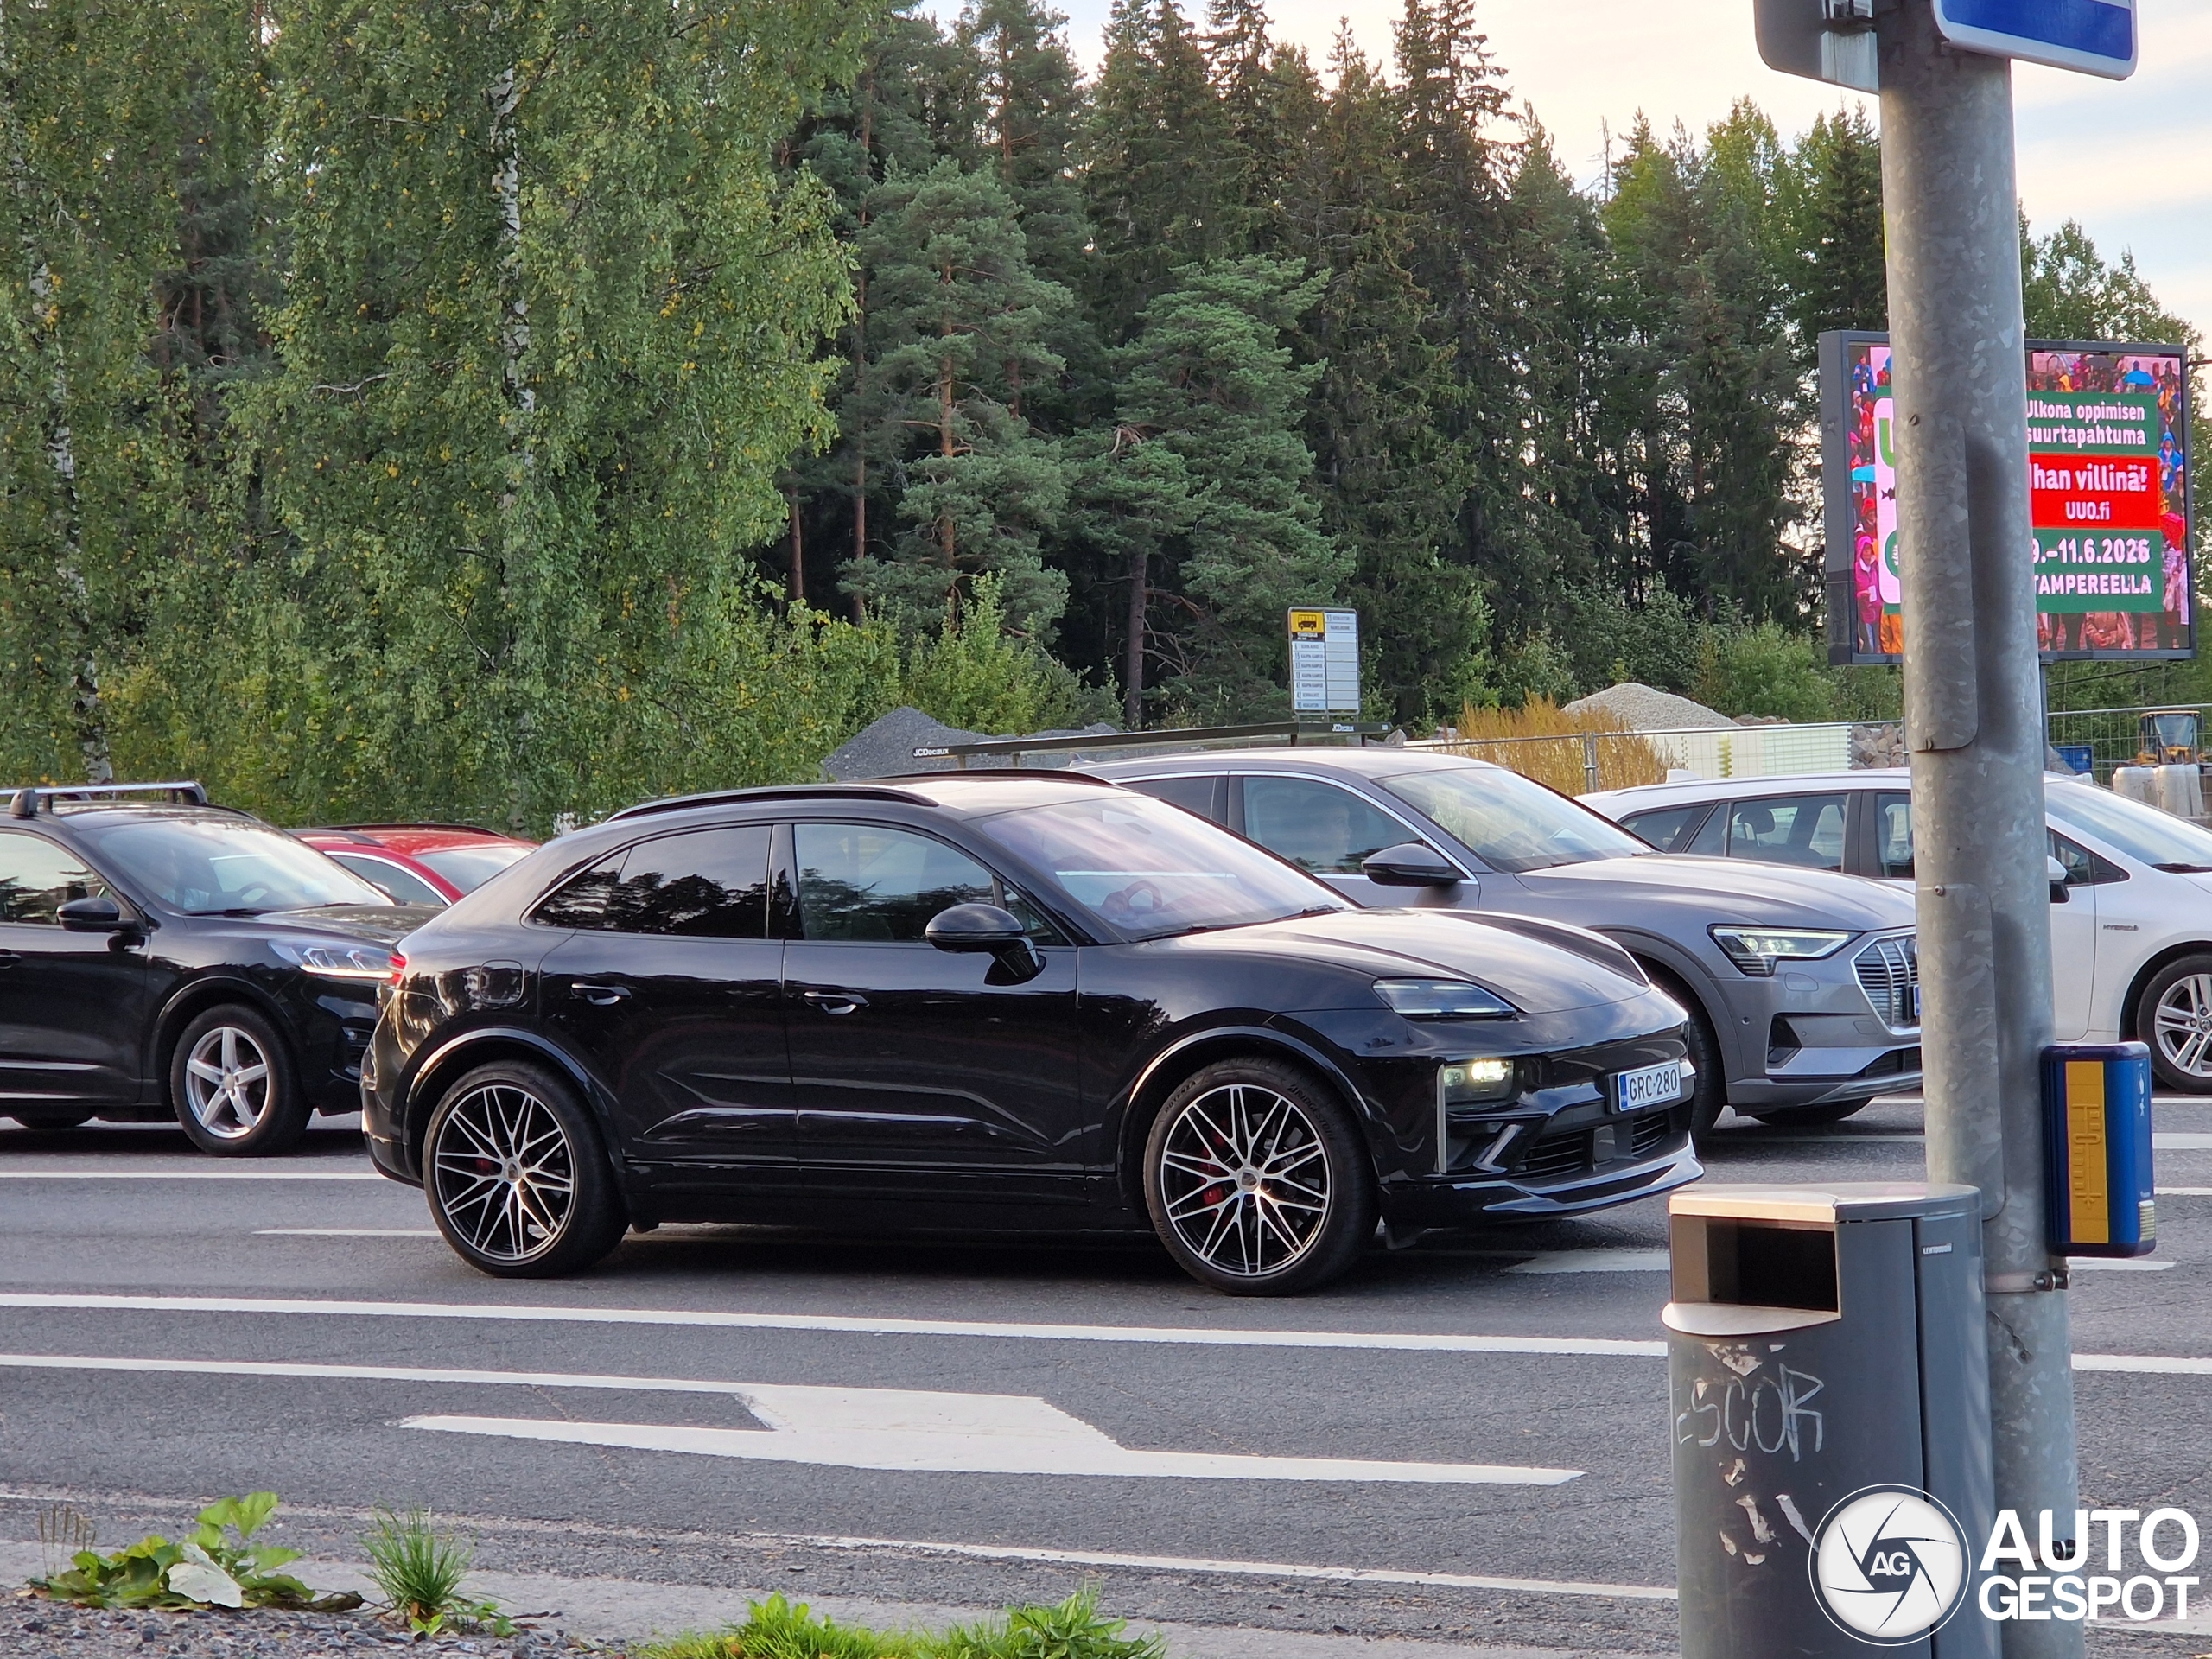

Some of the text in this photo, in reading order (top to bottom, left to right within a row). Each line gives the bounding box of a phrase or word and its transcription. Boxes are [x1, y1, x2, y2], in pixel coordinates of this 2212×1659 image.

[2076, 400, 2146, 424] oppimisen
[2075, 463, 2149, 492] villinä!
[2064, 501, 2111, 520] UUO.fi
[913, 748, 950, 757] JCDecaux
[1629, 1069, 1678, 1102] GRC-280
